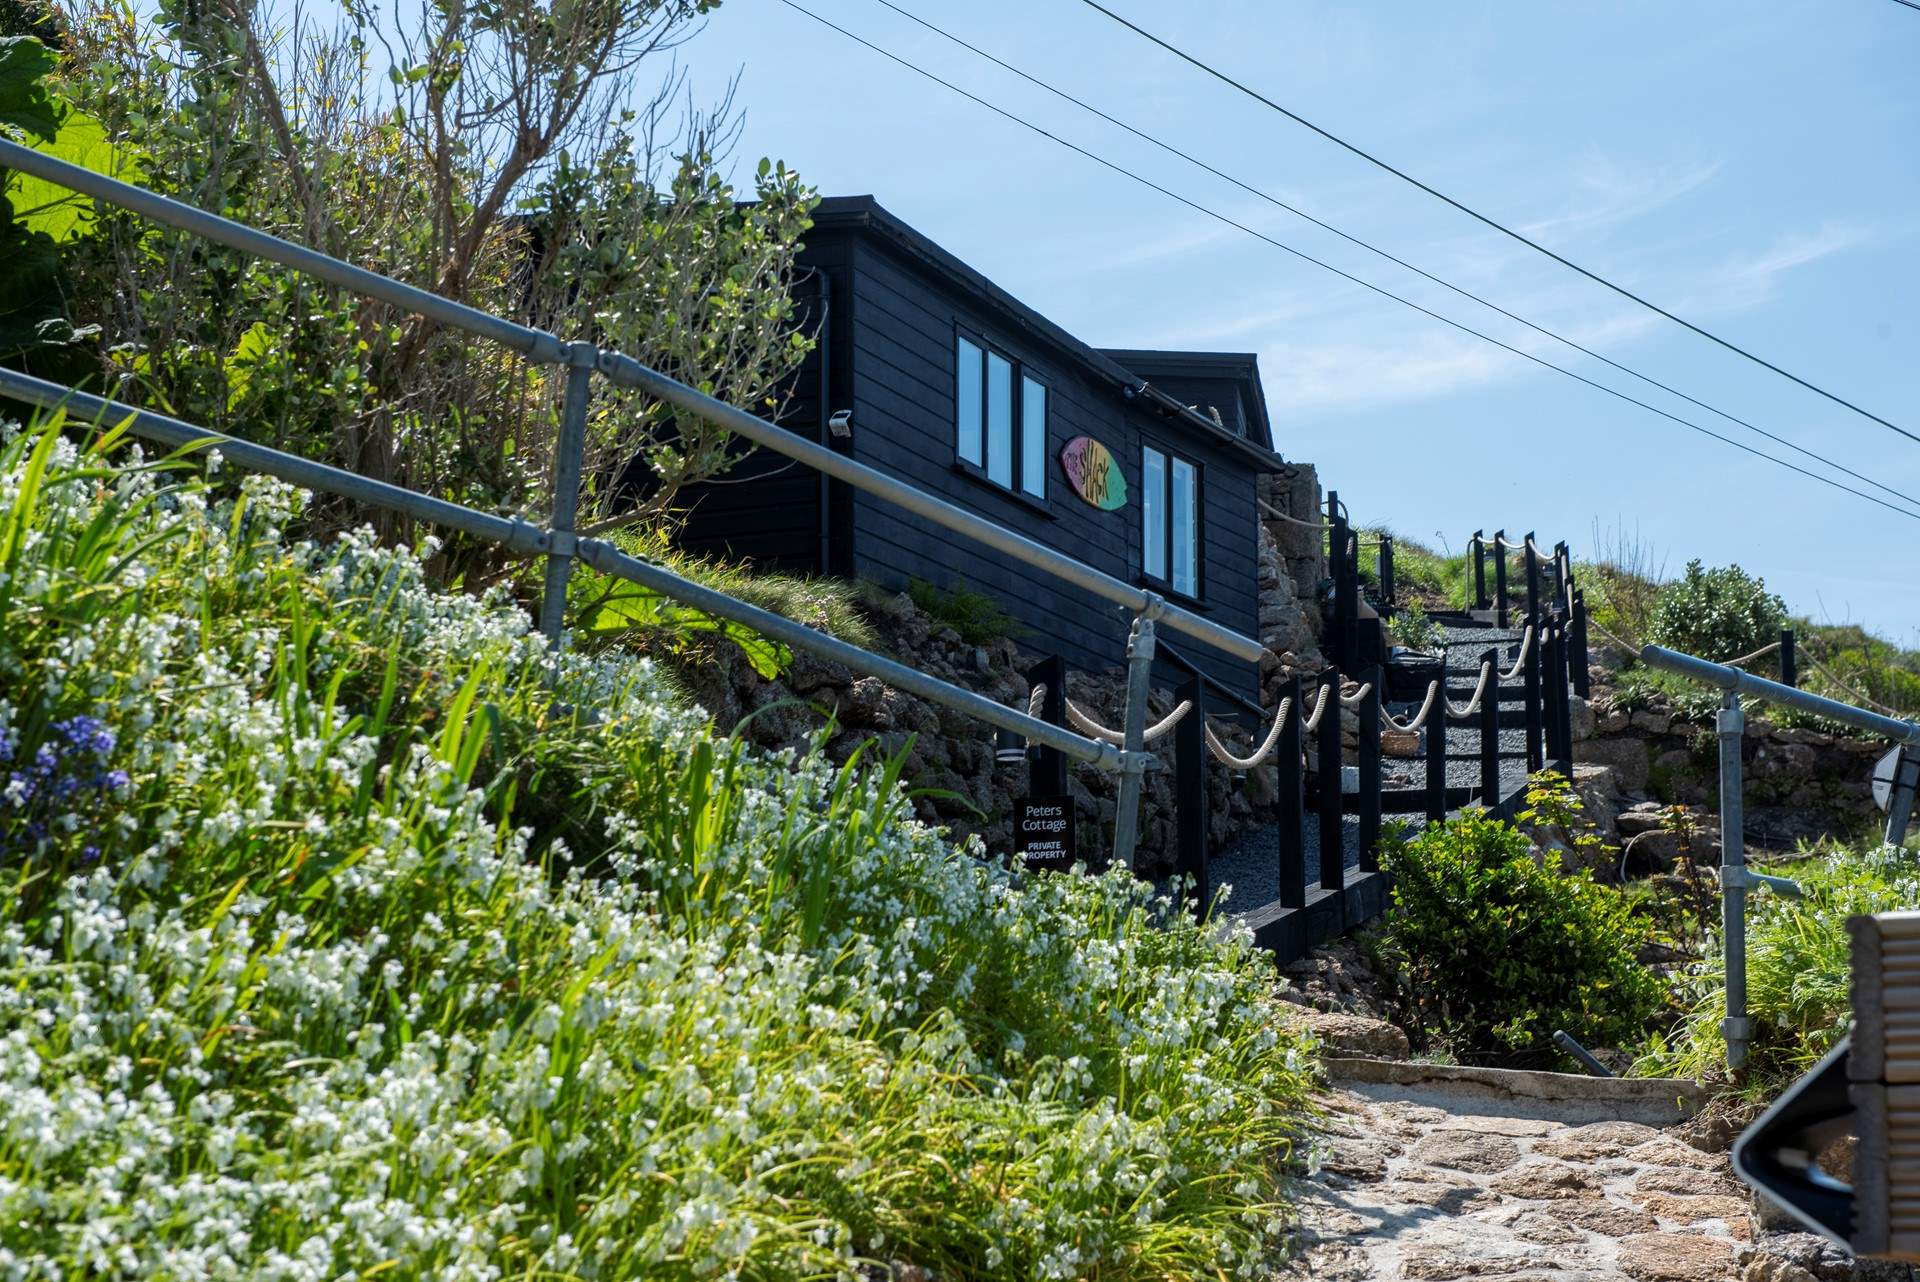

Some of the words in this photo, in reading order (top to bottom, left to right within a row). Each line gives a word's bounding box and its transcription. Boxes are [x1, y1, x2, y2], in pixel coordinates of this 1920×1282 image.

[1080, 438, 1110, 504] SHACK
[1026, 805, 1062, 817] Peters
[1022, 819, 1067, 833] Cottage
[1028, 841, 1061, 850] PRIVATE
